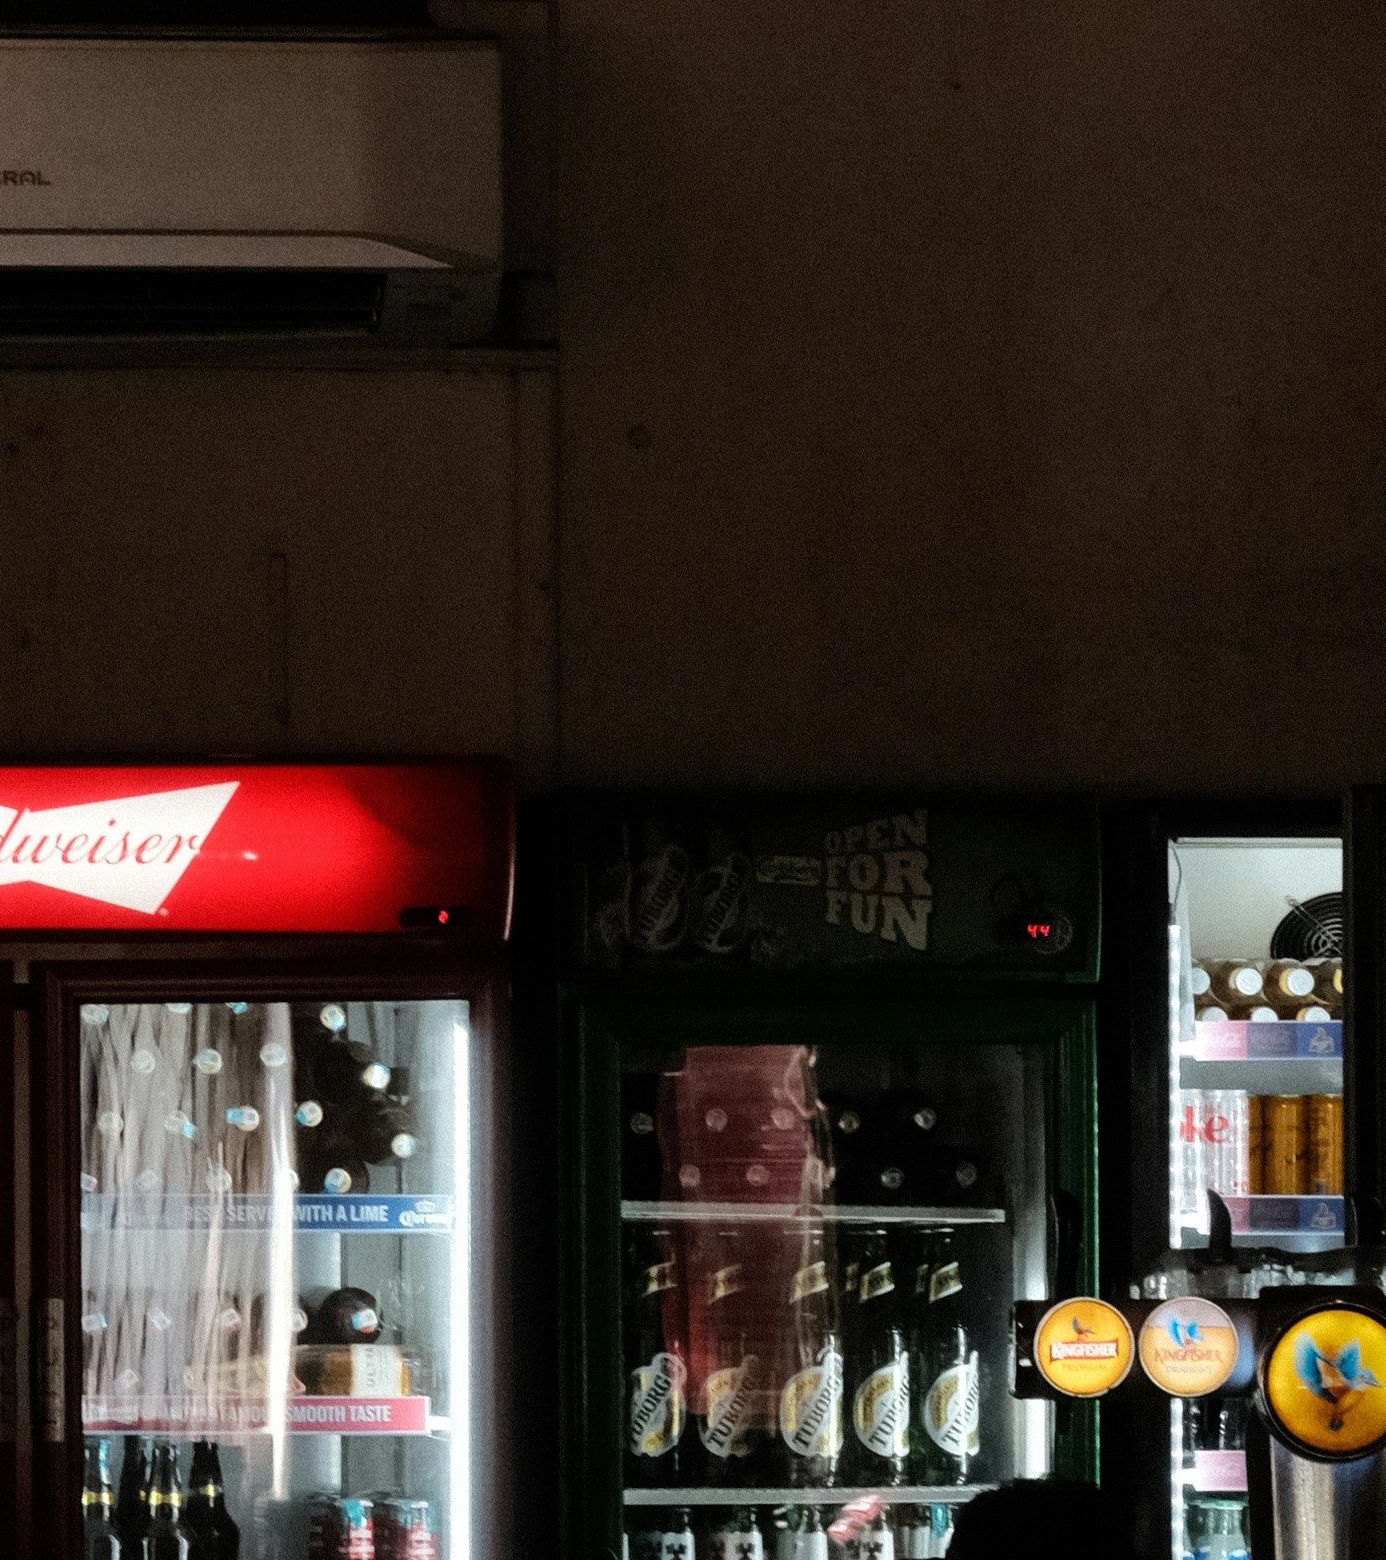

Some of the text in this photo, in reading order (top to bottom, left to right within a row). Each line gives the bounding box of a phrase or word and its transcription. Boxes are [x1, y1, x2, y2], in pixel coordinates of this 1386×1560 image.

[825, 807, 929, 856] OPEN
[825, 849, 933, 895] FOR
[700, 872, 744, 945] TUBORG
[825, 889, 933, 952] FUN
[335, 1204, 349, 1223] A
[350, 1204, 389, 1223] LIME
[1050, 1341, 1117, 1359] KINGFISHER
[286, 1404, 346, 1423] SMOOTH
[348, 1404, 393, 1423] TASTE
[707, 1375, 758, 1449] TUBORG
